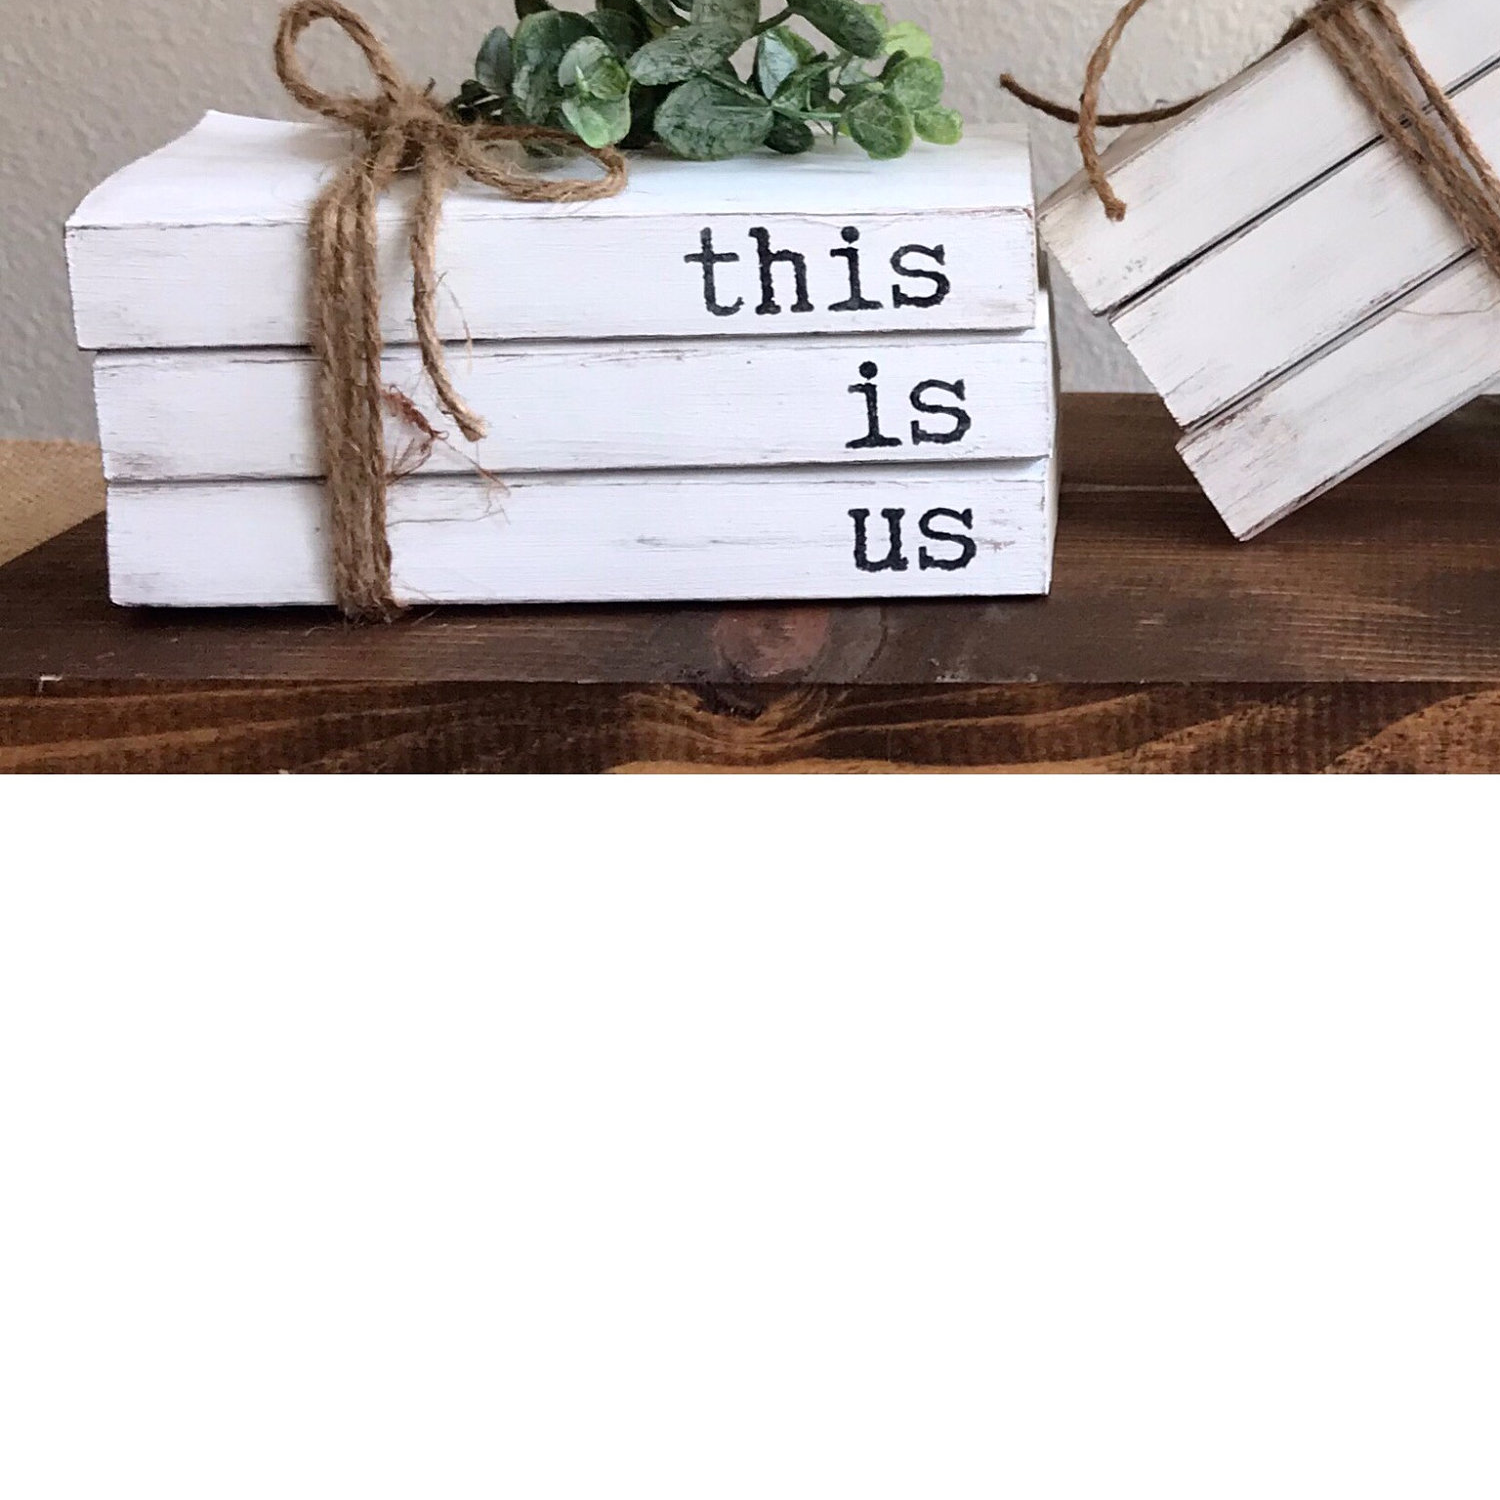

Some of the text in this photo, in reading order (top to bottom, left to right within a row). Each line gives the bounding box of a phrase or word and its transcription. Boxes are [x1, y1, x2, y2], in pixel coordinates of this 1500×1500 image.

[683, 225, 951, 317] this
[845, 360, 972, 450] is
[847, 506, 979, 573] us
